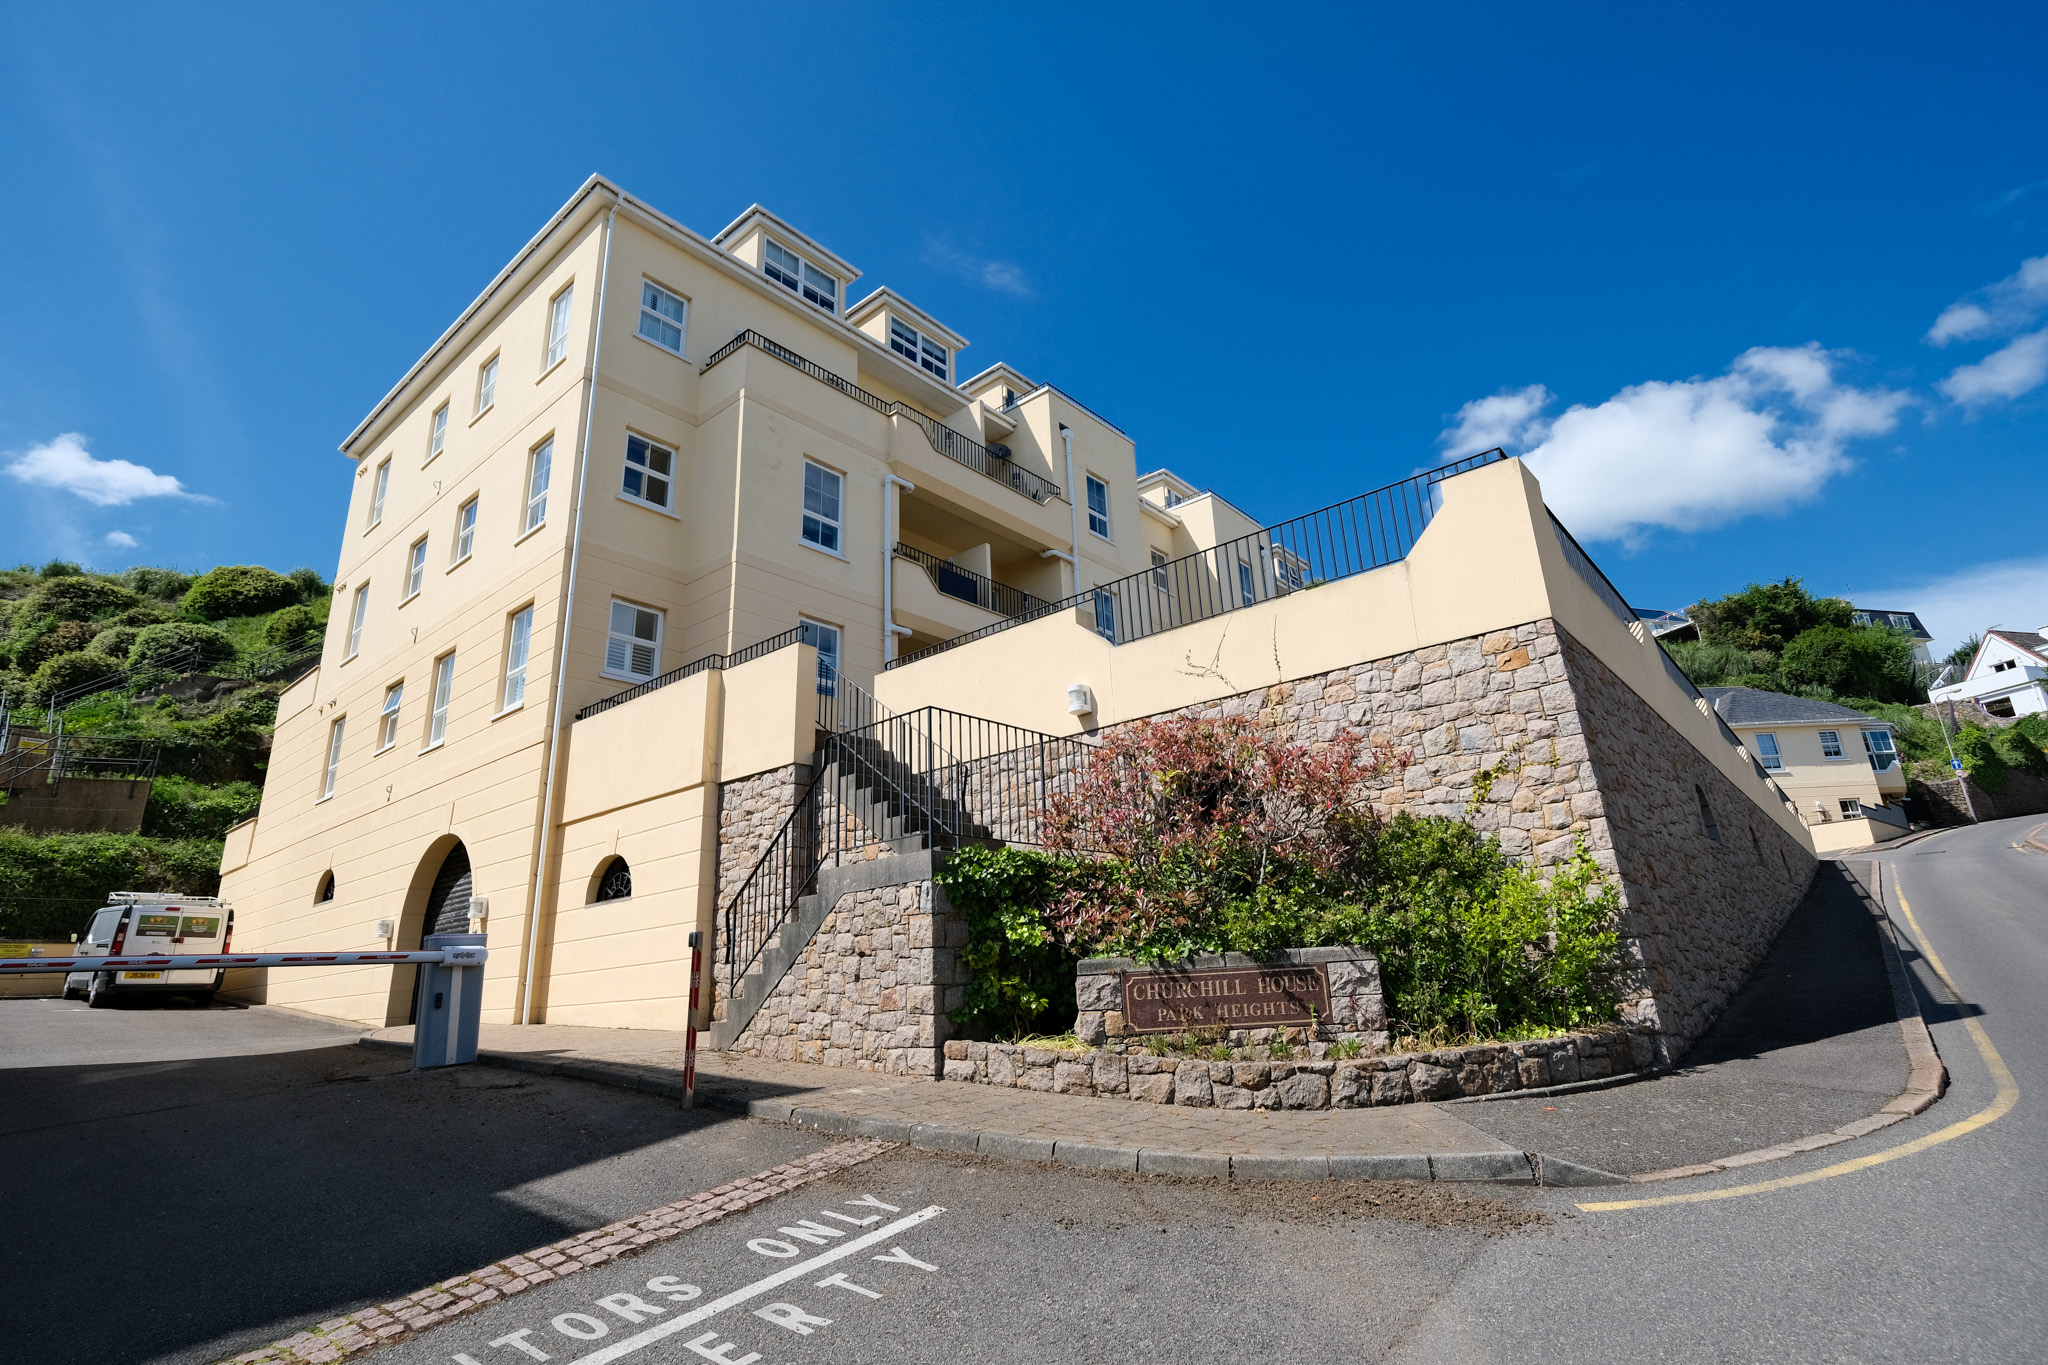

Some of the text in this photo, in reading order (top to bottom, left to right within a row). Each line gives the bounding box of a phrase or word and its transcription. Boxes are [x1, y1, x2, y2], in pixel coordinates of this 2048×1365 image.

[1133, 973, 1320, 1001] CHURCHILL HOUSE
[1157, 1000, 1301, 1022] PARK HEIGHTS
[746, 1193, 901, 1258] ONLY
[682, 1246, 939, 1365] ERTY
